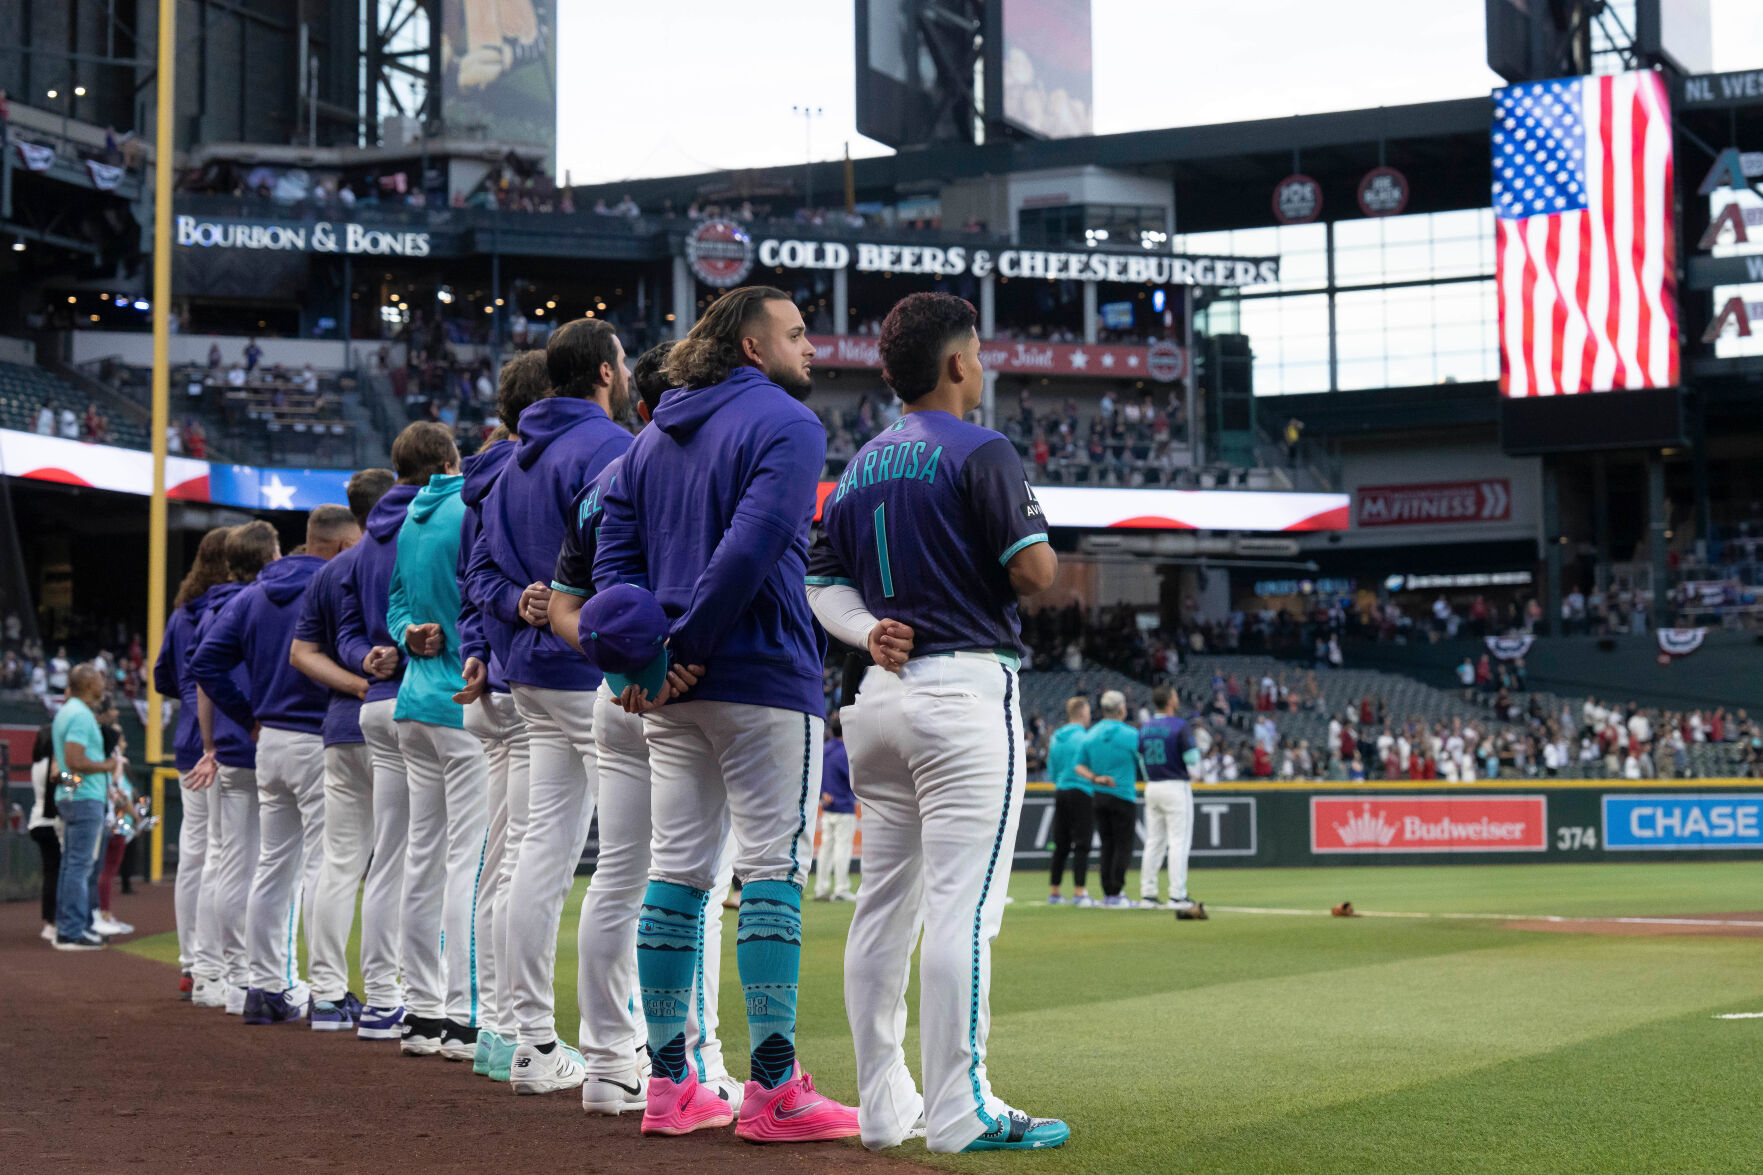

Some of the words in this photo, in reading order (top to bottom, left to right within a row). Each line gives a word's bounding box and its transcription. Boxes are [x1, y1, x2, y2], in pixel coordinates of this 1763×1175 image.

[1685, 77, 1715, 102] NL
[311, 222, 338, 252] &
[758, 239, 850, 270] COLD
[855, 243, 966, 275] BEERS
[971, 250, 993, 277] &
[999, 249, 1281, 287] CHEESEBURGERS
[835, 441, 943, 503] BARROSA
[579, 484, 602, 529] DEL
[874, 501, 894, 598] 1
[1403, 816, 1526, 841] Budweiser
[1630, 806, 1760, 838] CHASE
[1556, 827, 1596, 850] 374
